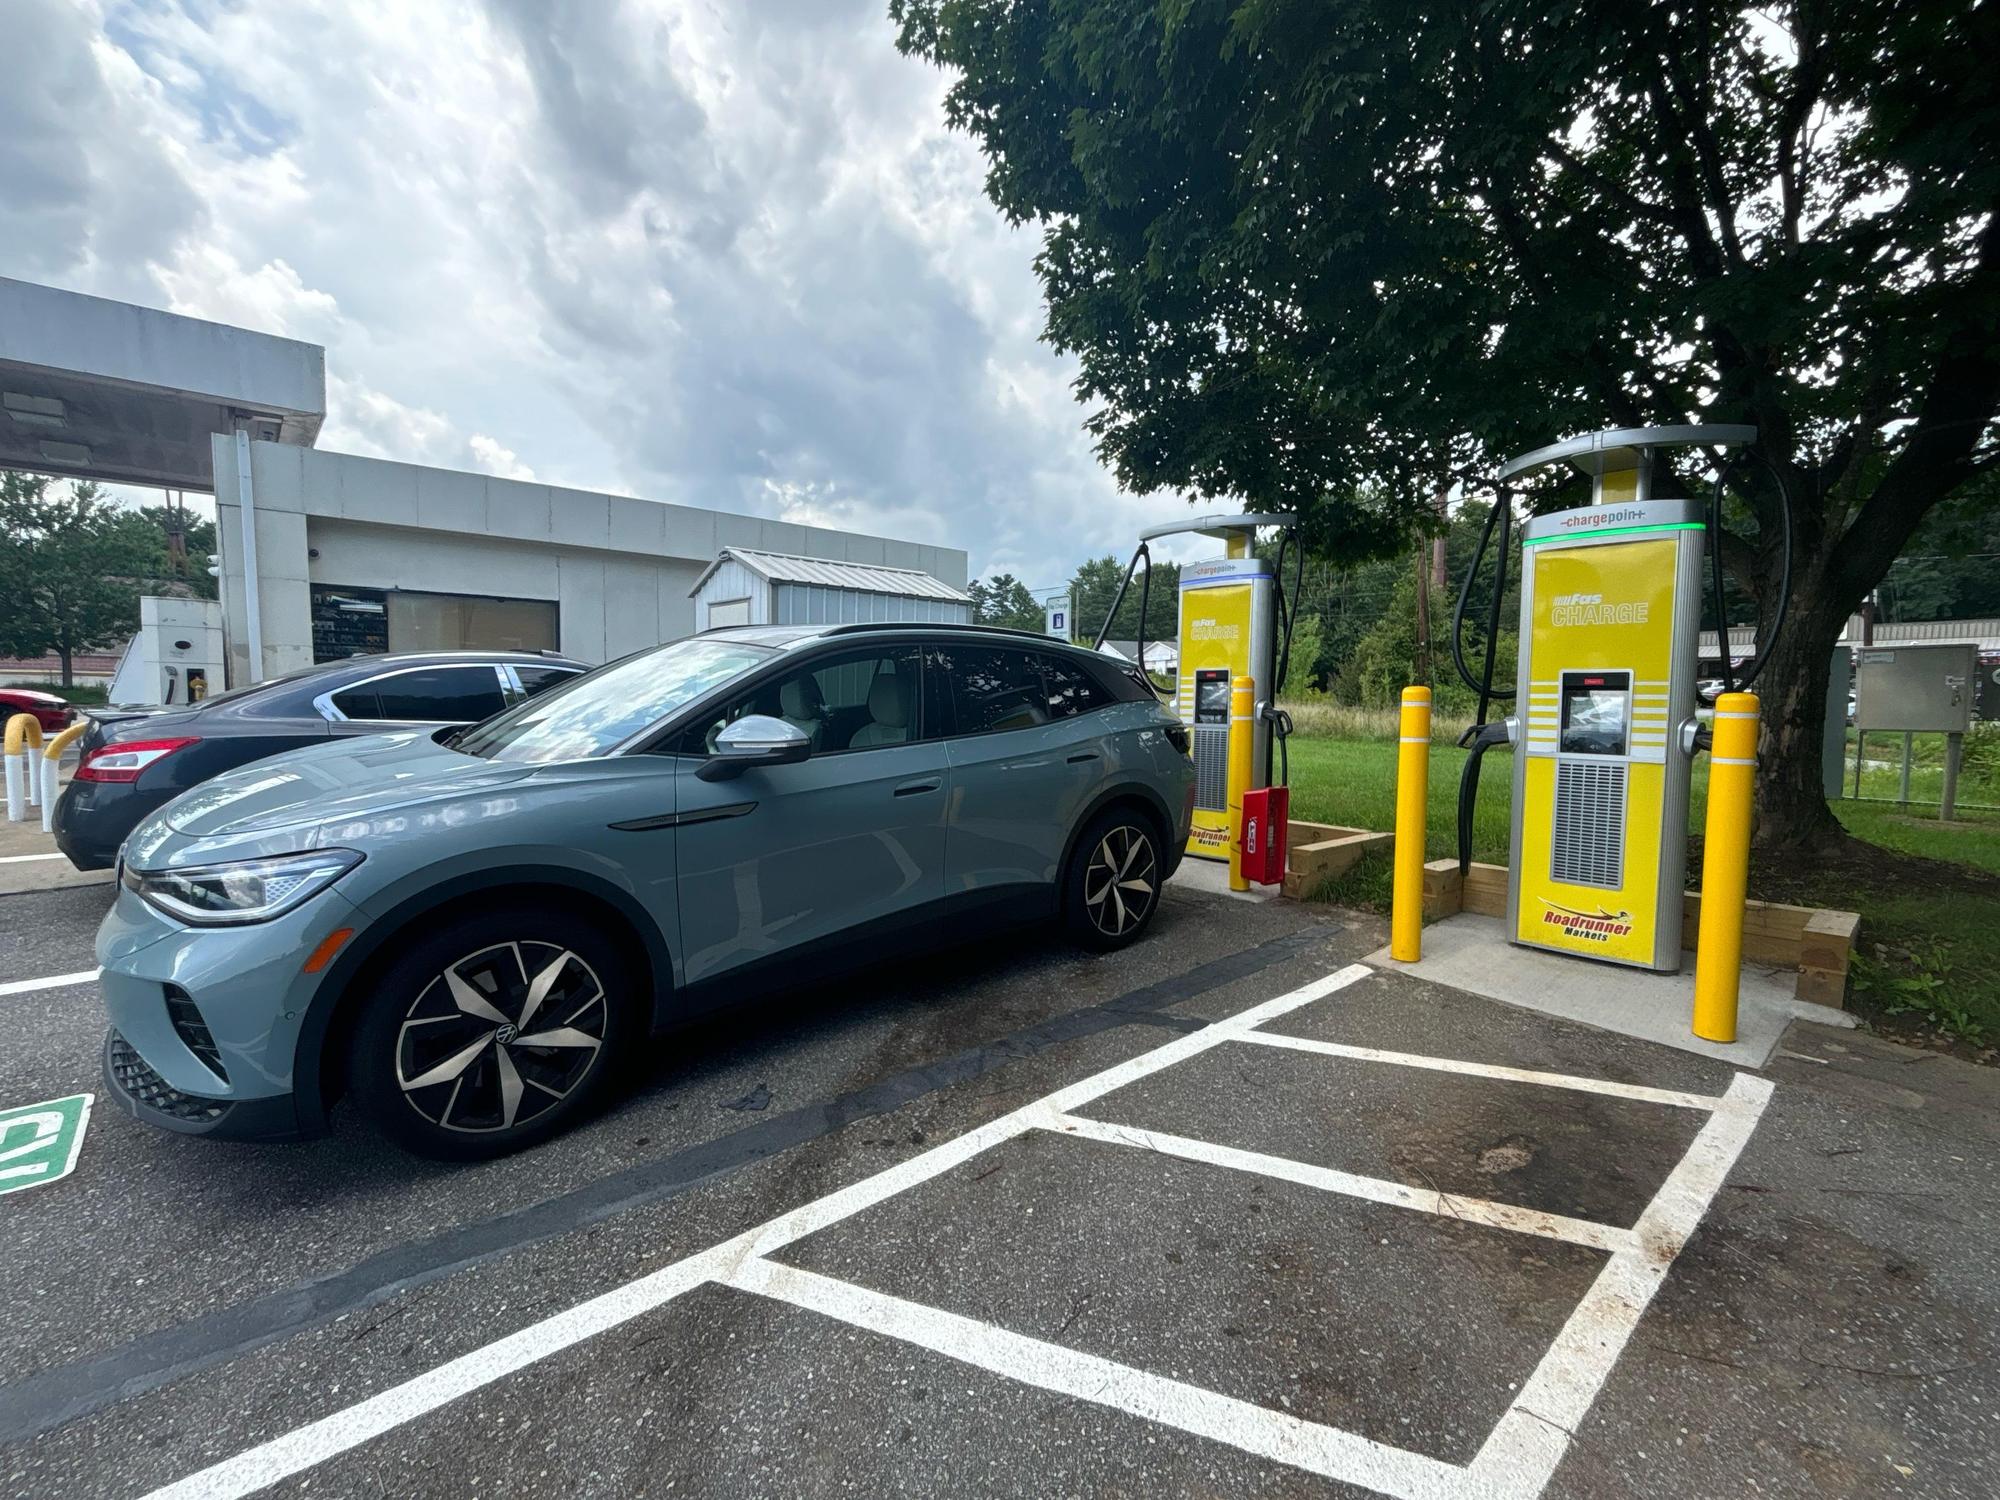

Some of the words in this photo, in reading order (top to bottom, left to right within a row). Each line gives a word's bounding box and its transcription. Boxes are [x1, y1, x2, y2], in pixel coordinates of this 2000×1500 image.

[1561, 509, 1645, 527] chargepoint
[1552, 602, 1648, 626] CHARGE
[1192, 626, 1240, 640] CHARGE
[1544, 911, 1631, 935] Roadrunner
[1564, 927, 1608, 941] Markets
